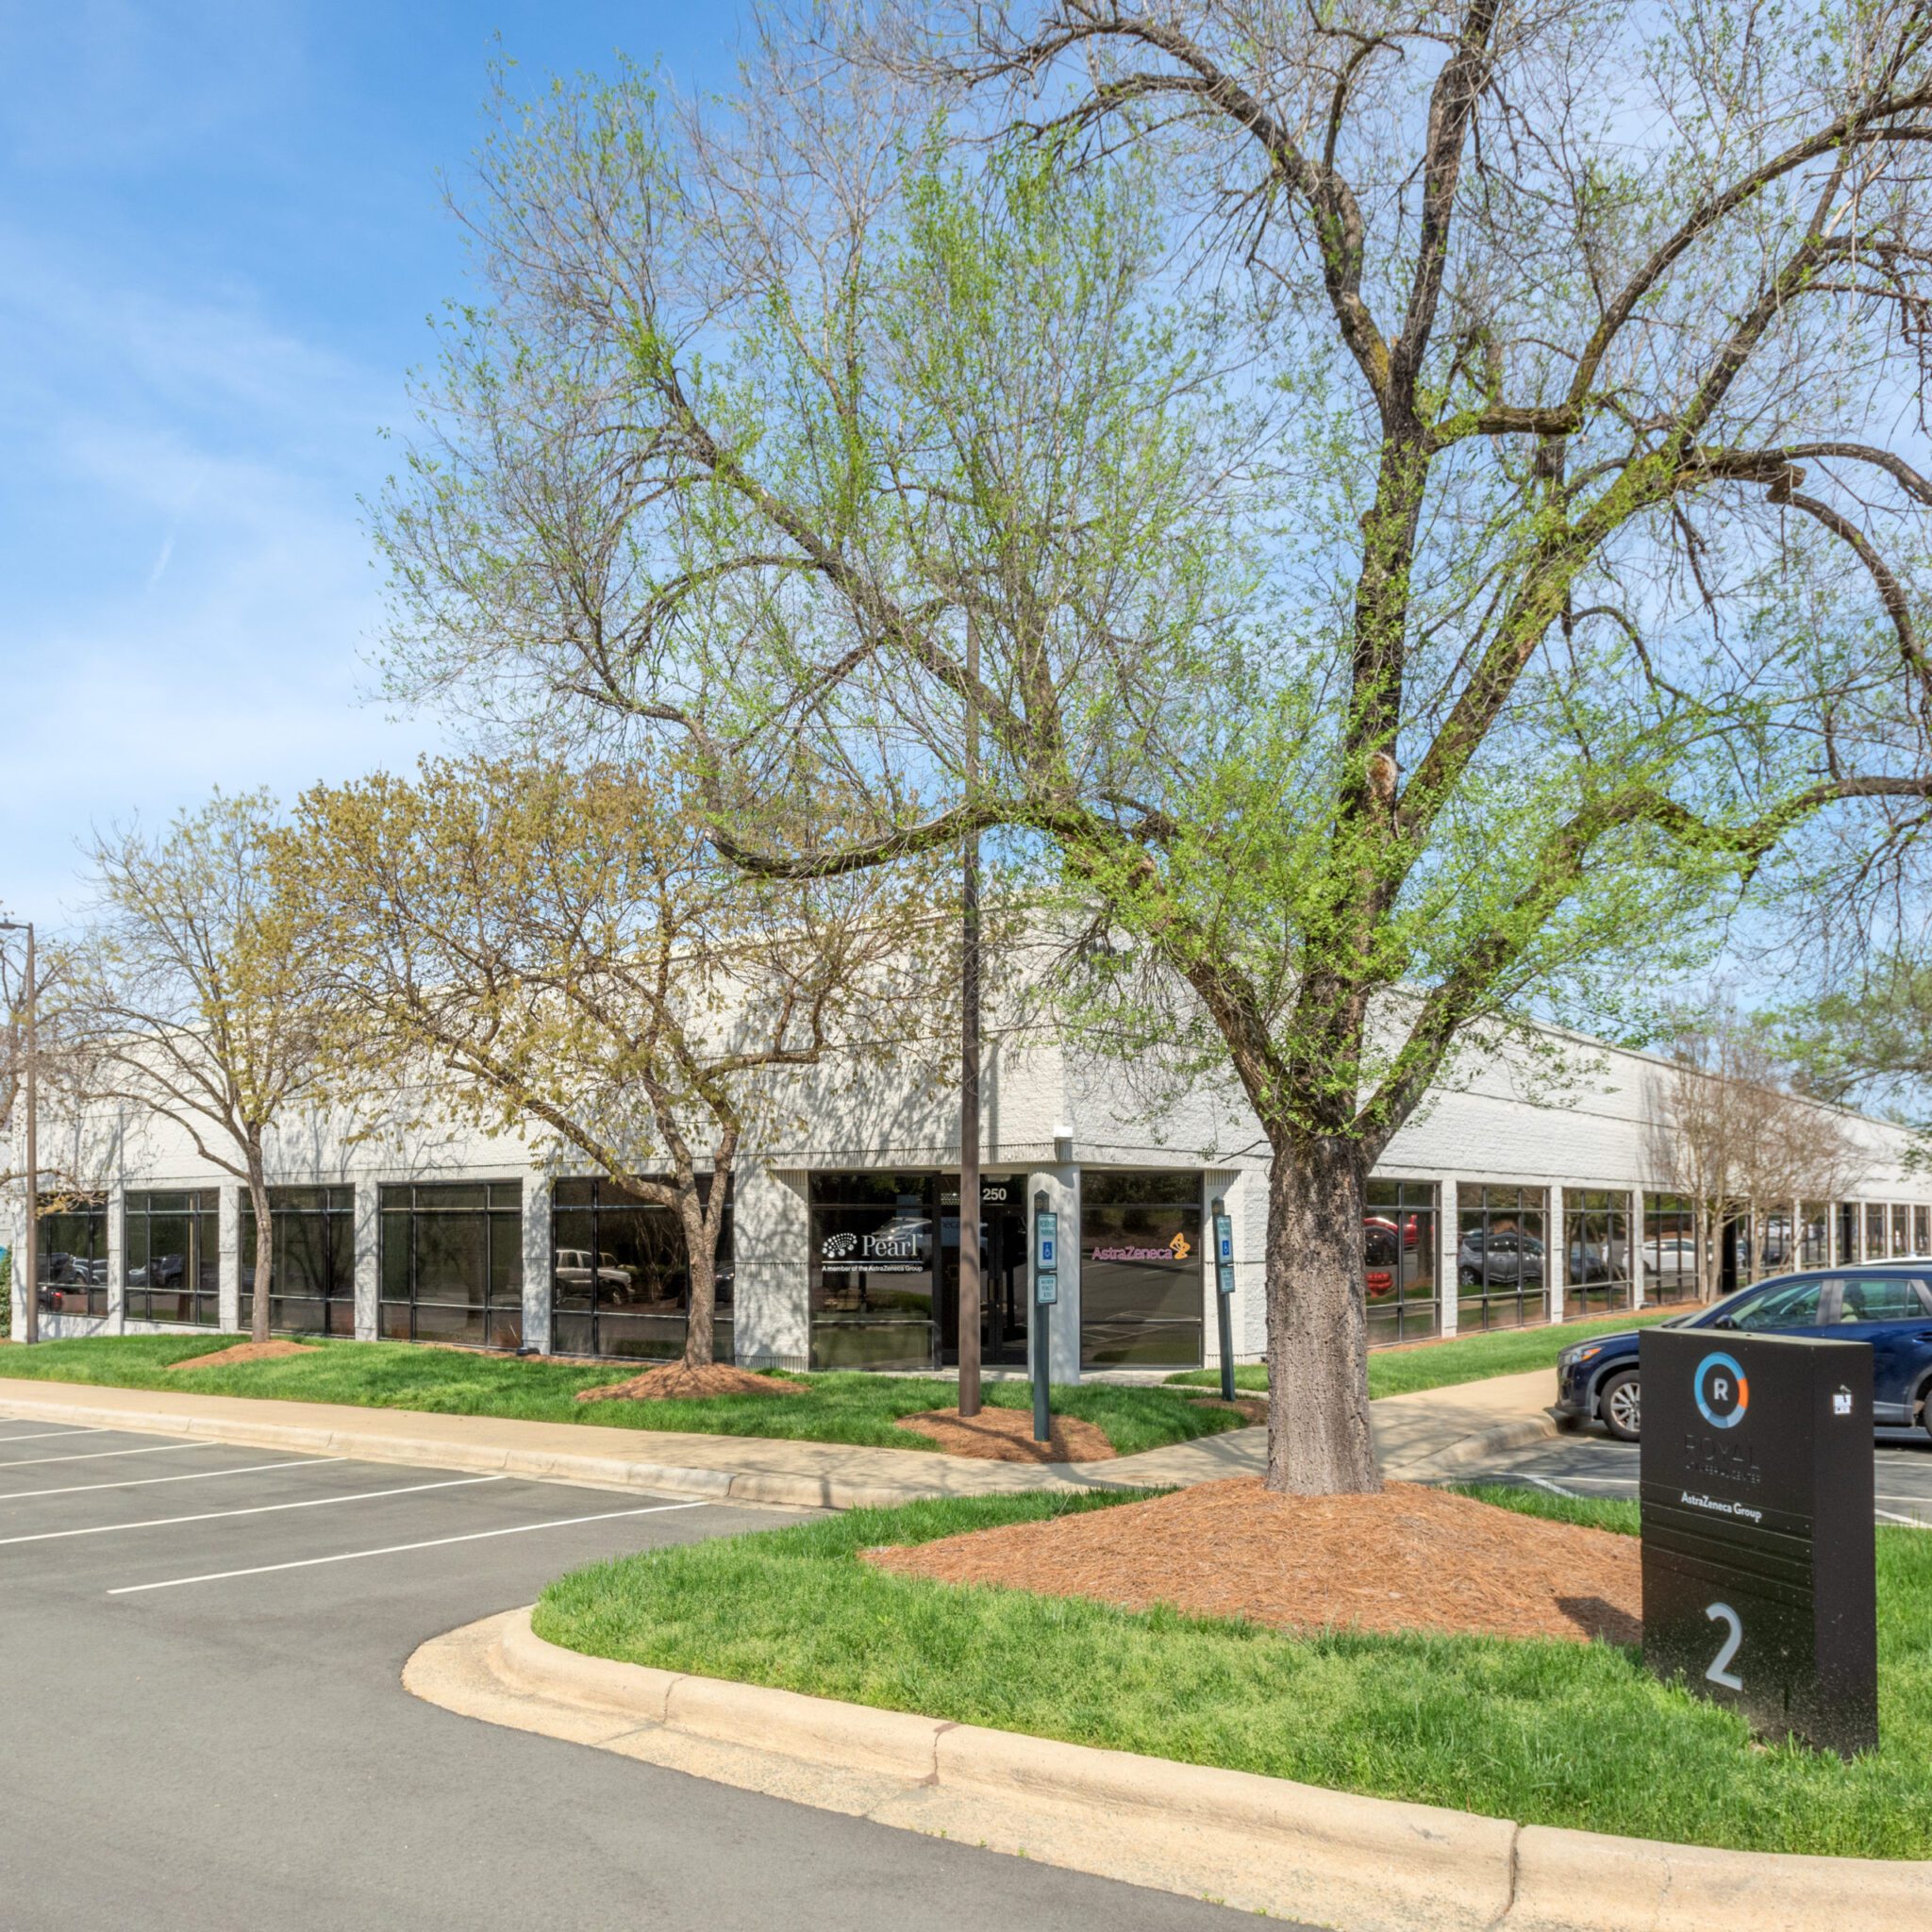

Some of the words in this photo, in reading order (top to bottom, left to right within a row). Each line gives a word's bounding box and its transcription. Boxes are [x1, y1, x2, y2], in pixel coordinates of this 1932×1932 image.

[982, 1188, 1008, 1201] 250
[1091, 1246, 1173, 1260] AstraZeneca
[905, 1265, 924, 1274] Group
[1713, 1377, 1729, 1401] R
[1681, 1491, 1732, 1513] AstraZeneca
[1733, 1502, 1762, 1524] Group
[1706, 1602, 1742, 1691] 2
